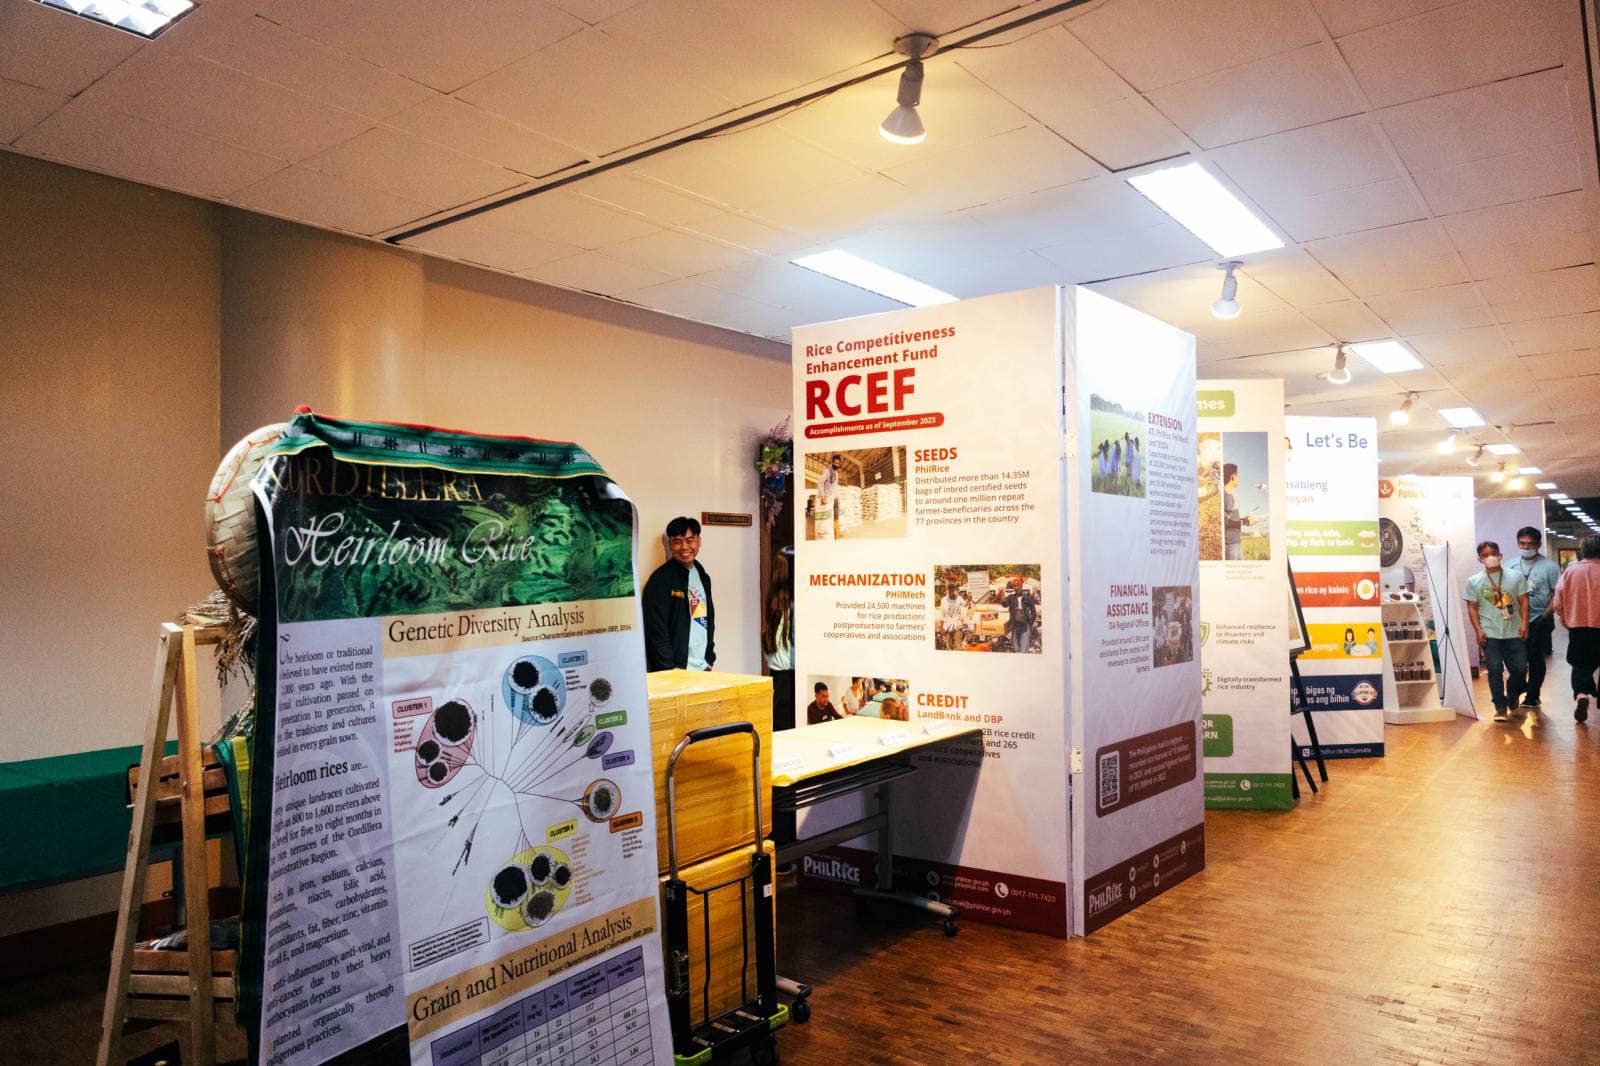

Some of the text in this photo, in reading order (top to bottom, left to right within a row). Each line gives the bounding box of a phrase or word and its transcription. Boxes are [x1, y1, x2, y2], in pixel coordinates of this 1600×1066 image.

[806, 327, 955, 357] Rice Competitiveness
[806, 345, 938, 374] Enhancement Fund
[806, 368, 916, 420] RCEF
[810, 424, 864, 435] Accomplishments
[883, 418, 918, 429] September
[920, 416, 936, 425] 2023
[1148, 411, 1182, 431] EXTENSION
[1306, 432, 1368, 449] Let's Be
[915, 447, 958, 462] SEEDS
[916, 465, 949, 473] PhilRice
[916, 471, 1030, 484] Distributed more than 14.35M
[916, 488, 933, 496] bags
[944, 485, 968, 493] inbred
[970, 483, 1002, 492] certified
[970, 494, 996, 502] million
[999, 494, 1025, 503] repeat
[916, 506, 992, 515] farmer-beneficiaries
[926, 516, 962, 526] provinces
[973, 515, 986, 523] the
[988, 515, 1019, 524] country
[284, 512, 535, 566] Heirloom Rice
[809, 573, 926, 587] MECHANIZATION
[886, 590, 925, 599] PHilMech
[1110, 584, 1149, 598] FINANCIAL
[836, 601, 866, 609] Provided
[891, 602, 926, 610] machines
[1106, 602, 1149, 617] ASSISTANCE
[388, 619, 454, 643] Genetic
[457, 614, 521, 638] Diversity
[528, 605, 585, 631] Analysis
[834, 622, 885, 630] postproduction
[823, 631, 926, 641] cooperatives and associations
[295, 645, 373, 663] heirloom or traditional
[311, 661, 373, 676] have existed more
[299, 674, 373, 693] years ago. With the
[1230, 683, 1256, 691] industry
[1306, 685, 1324, 696] bigas
[295, 694, 331, 707] cultivation
[337, 688, 359, 703] passed
[365, 688, 373, 696] on
[917, 693, 969, 709] CREDIT
[315, 703, 365, 718] to generation,
[397, 703, 423, 713] CLUSTER
[295, 714, 376, 738] traditions and cultures
[963, 712, 982, 723] and
[984, 714, 1003, 724] DBP
[994, 729, 1035, 741] rice credit
[300, 740, 317, 753] every
[319, 735, 337, 749] grain
[986, 739, 1001, 748] and
[1003, 740, 1019, 751] 265
[320, 761, 348, 779] rices
[309, 788, 343, 804] landraces
[345, 778, 380, 795] cultivated
[335, 793, 381, 813] meters above
[301, 810, 373, 838] five eight months
[290, 821, 383, 856] terraces the Cordillera
[311, 848, 338, 864] Region.
[322, 868, 351, 884] sodium,
[343, 878, 359, 892] folic
[361, 898, 388, 915] vitamin
[290, 942, 304, 957] and
[306, 928, 351, 951] magnesium.
[377, 932, 391, 947] and
[310, 976, 324, 989] due
[346, 959, 364, 974] their
[370, 948, 391, 964] heavy
[413, 986, 461, 1022] Grain
[465, 968, 497, 999] and
[500, 933, 577, 985] Nutritional
[581, 912, 632, 949] Analysis
[310, 984, 341, 1006] deposits
[312, 1001, 355, 1028] organically
[365, 983, 394, 1004] through
[307, 1023, 343, 1050] practices.
